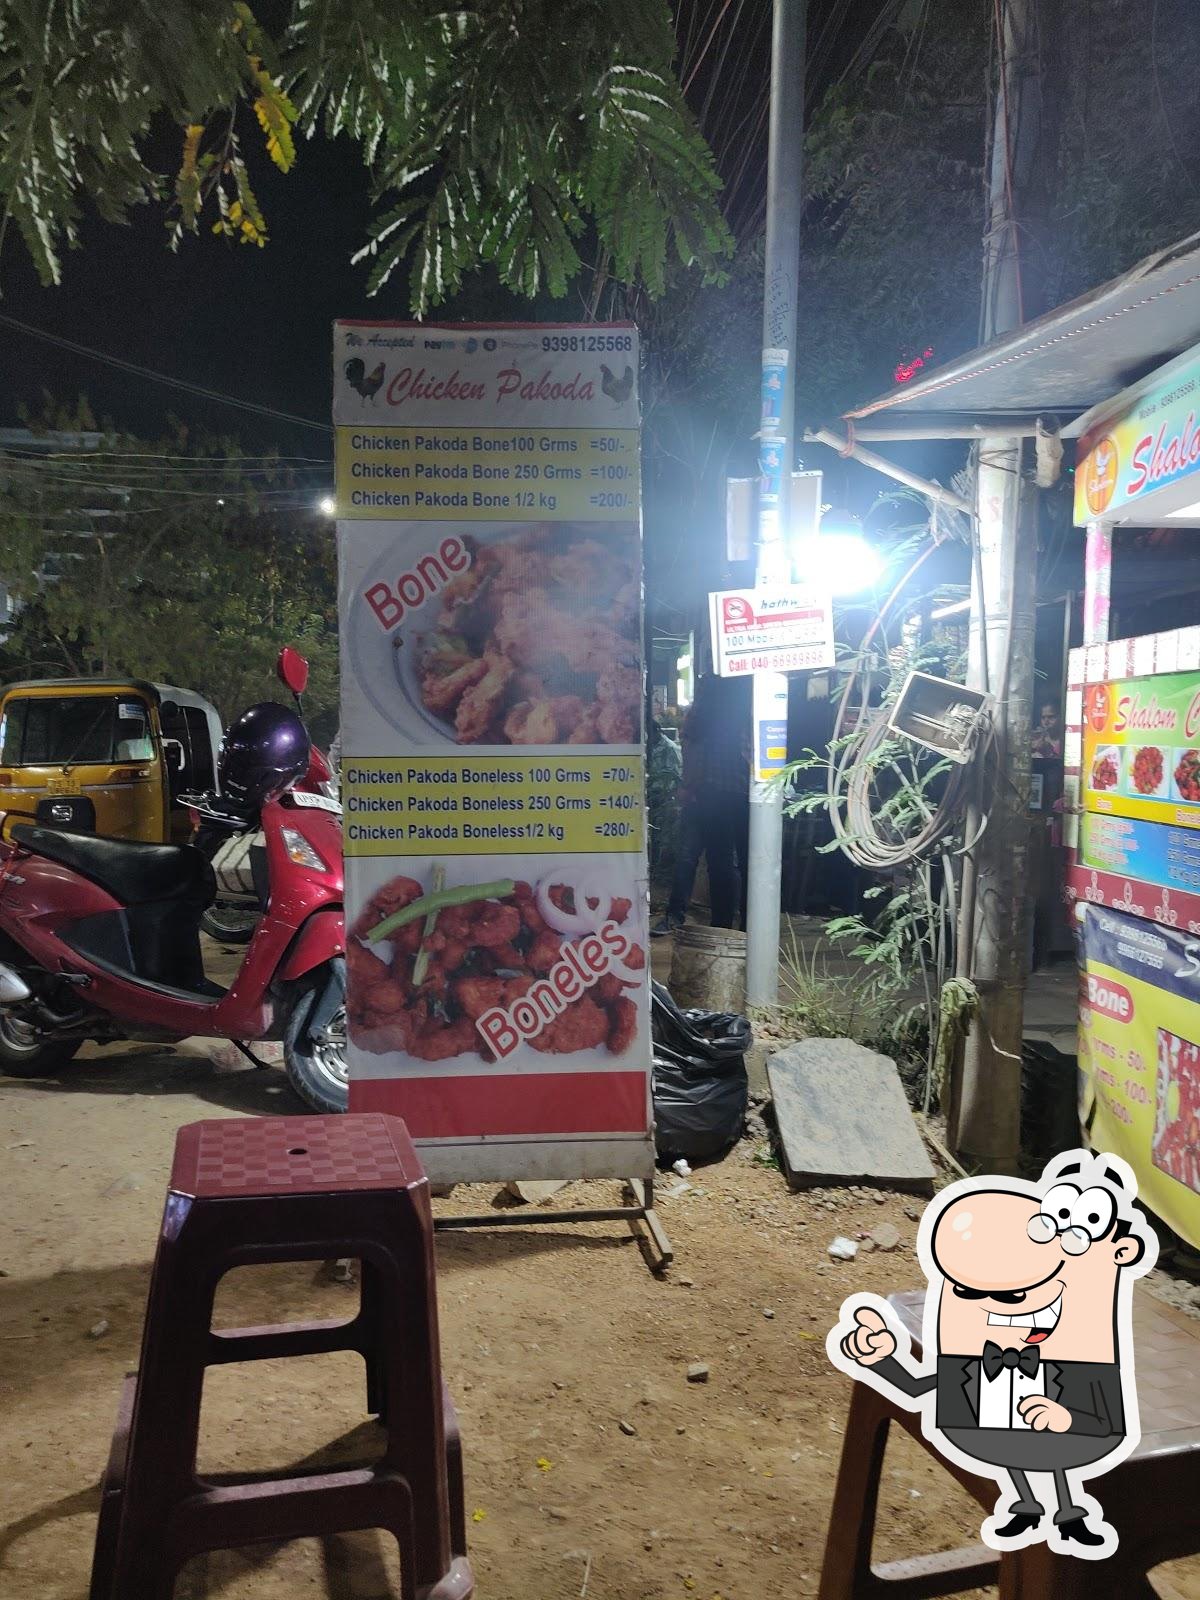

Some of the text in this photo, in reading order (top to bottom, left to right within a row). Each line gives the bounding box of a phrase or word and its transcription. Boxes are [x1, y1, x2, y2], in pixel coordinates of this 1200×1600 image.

[541, 336, 632, 352] 9398125568
[386, 367, 595, 406] Chicken Pakoda
[351, 434, 410, 451] Chicken
[414, 435, 468, 451] Pakoda
[539, 437, 578, 452] Grms
[351, 462, 410, 479] Chicken
[414, 463, 468, 479] Pakoda
[472, 464, 510, 480] Bone
[514, 464, 539, 480] 250
[543, 465, 582, 480] Grms
[351, 490, 410, 507] Chicken
[414, 490, 468, 507] Pakoda
[472, 491, 510, 507] Bone
[514, 492, 536, 508] 1/2
[539, 491, 557, 510] kg
[364, 537, 468, 631] Bone
[347, 768, 635, 784] Chicken Pakoda Boneless 100 Grms =70/-
[347, 795, 639, 812] Chicken Pakoda Boneless 250 Grms =140/-
[349, 824, 404, 840] Chicken
[407, 824, 458, 840] Pakoda
[548, 823, 564, 840] kg
[595, 822, 635, 837] =280/-
[478, 923, 629, 1058] Boneles
[1087, 976, 1130, 1017] Bone
